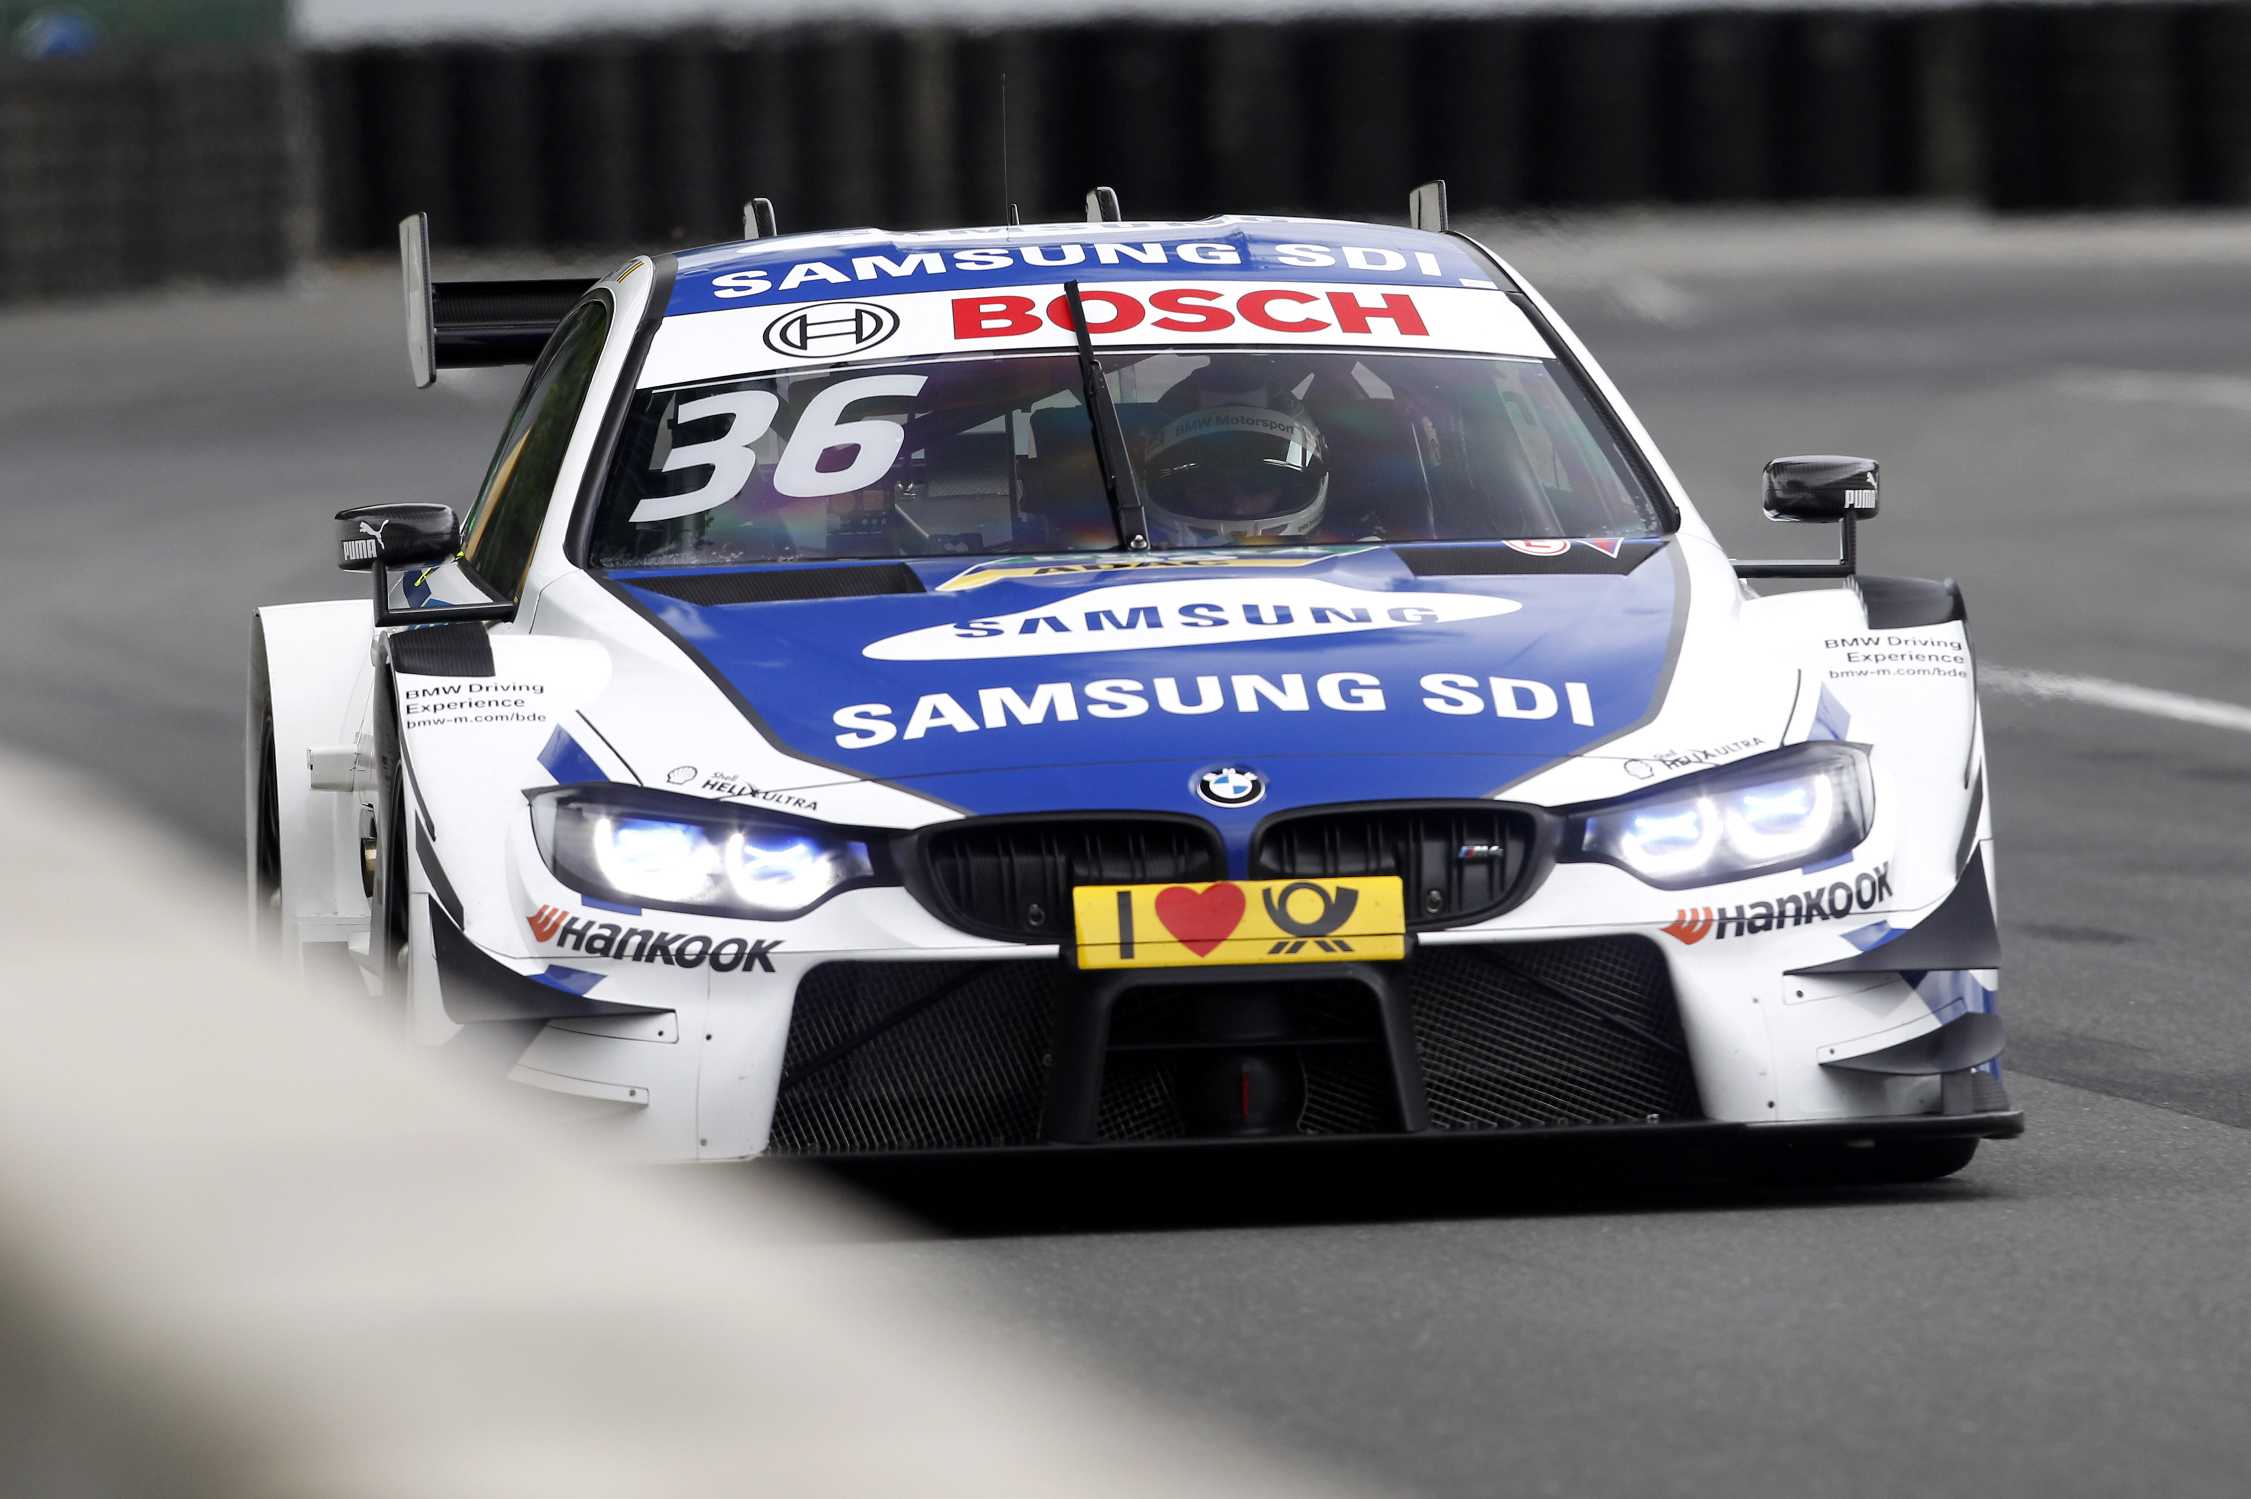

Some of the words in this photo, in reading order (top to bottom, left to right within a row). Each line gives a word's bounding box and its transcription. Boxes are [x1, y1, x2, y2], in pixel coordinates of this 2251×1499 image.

[712, 242, 1243, 298] SAMSUNG
[1275, 243, 1443, 277] SDI
[951, 288, 1430, 340] BOSCH
[628, 374, 928, 523] 36
[343, 538, 377, 561] PUMA
[953, 603, 1439, 638] SAMSUNG
[1824, 636, 1881, 649] BMW
[1887, 636, 1963, 650] Driving
[1846, 651, 1966, 664] Experience
[1829, 666, 1968, 679] bmw-m.com/bde
[405, 684, 463, 700] BMW
[468, 682, 545, 694] Driving
[406, 697, 526, 715] Experience
[832, 671, 1386, 749] SAMSUNG
[1418, 673, 1595, 727] SDI
[406, 711, 547, 729] bmw-m.com/bde
[761, 790, 819, 811] ULTRA
[1116, 890, 1135, 960] I
